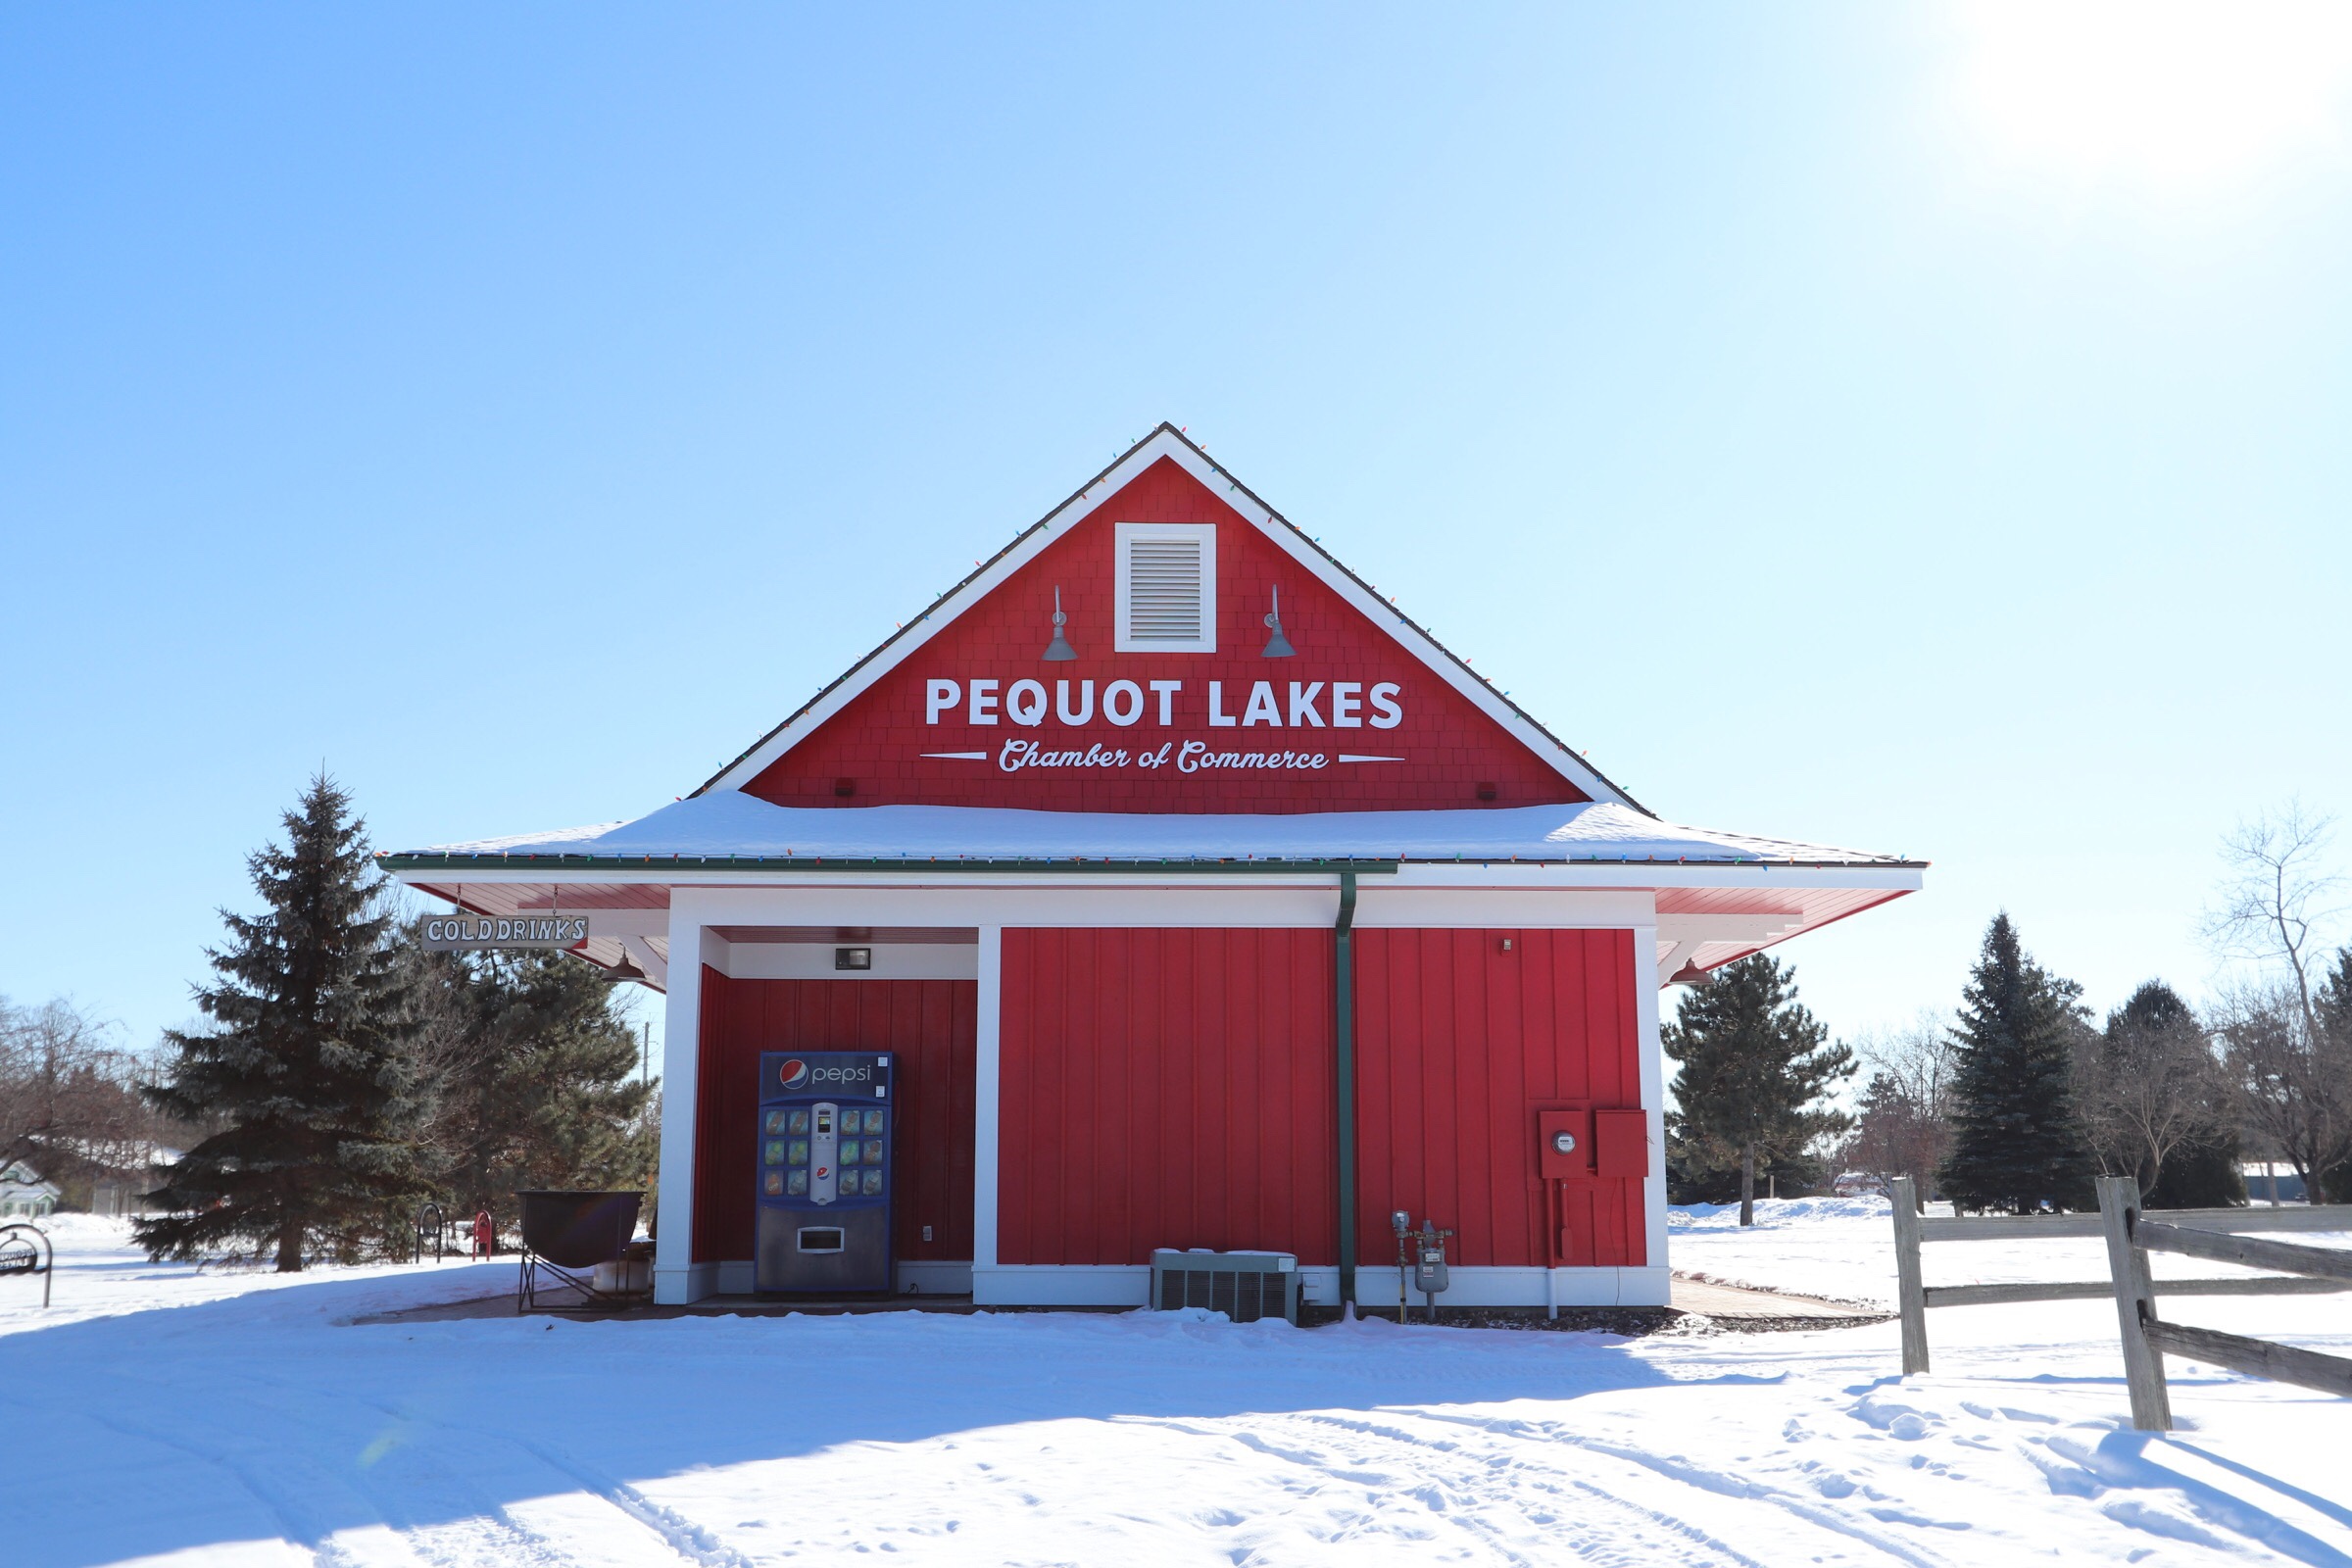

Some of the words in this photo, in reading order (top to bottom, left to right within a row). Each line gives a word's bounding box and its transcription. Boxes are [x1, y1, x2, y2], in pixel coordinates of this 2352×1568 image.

[926, 679, 1182, 727] PEQUOT
[1209, 680, 1402, 729] LAKES
[999, 738, 1131, 772] Chamber
[1138, 742, 1172, 769] of
[1177, 739, 1330, 773] Commerce
[427, 919, 492, 942] COLD
[495, 919, 586, 941] DRINKS
[812, 1064, 870, 1084] pepsi
